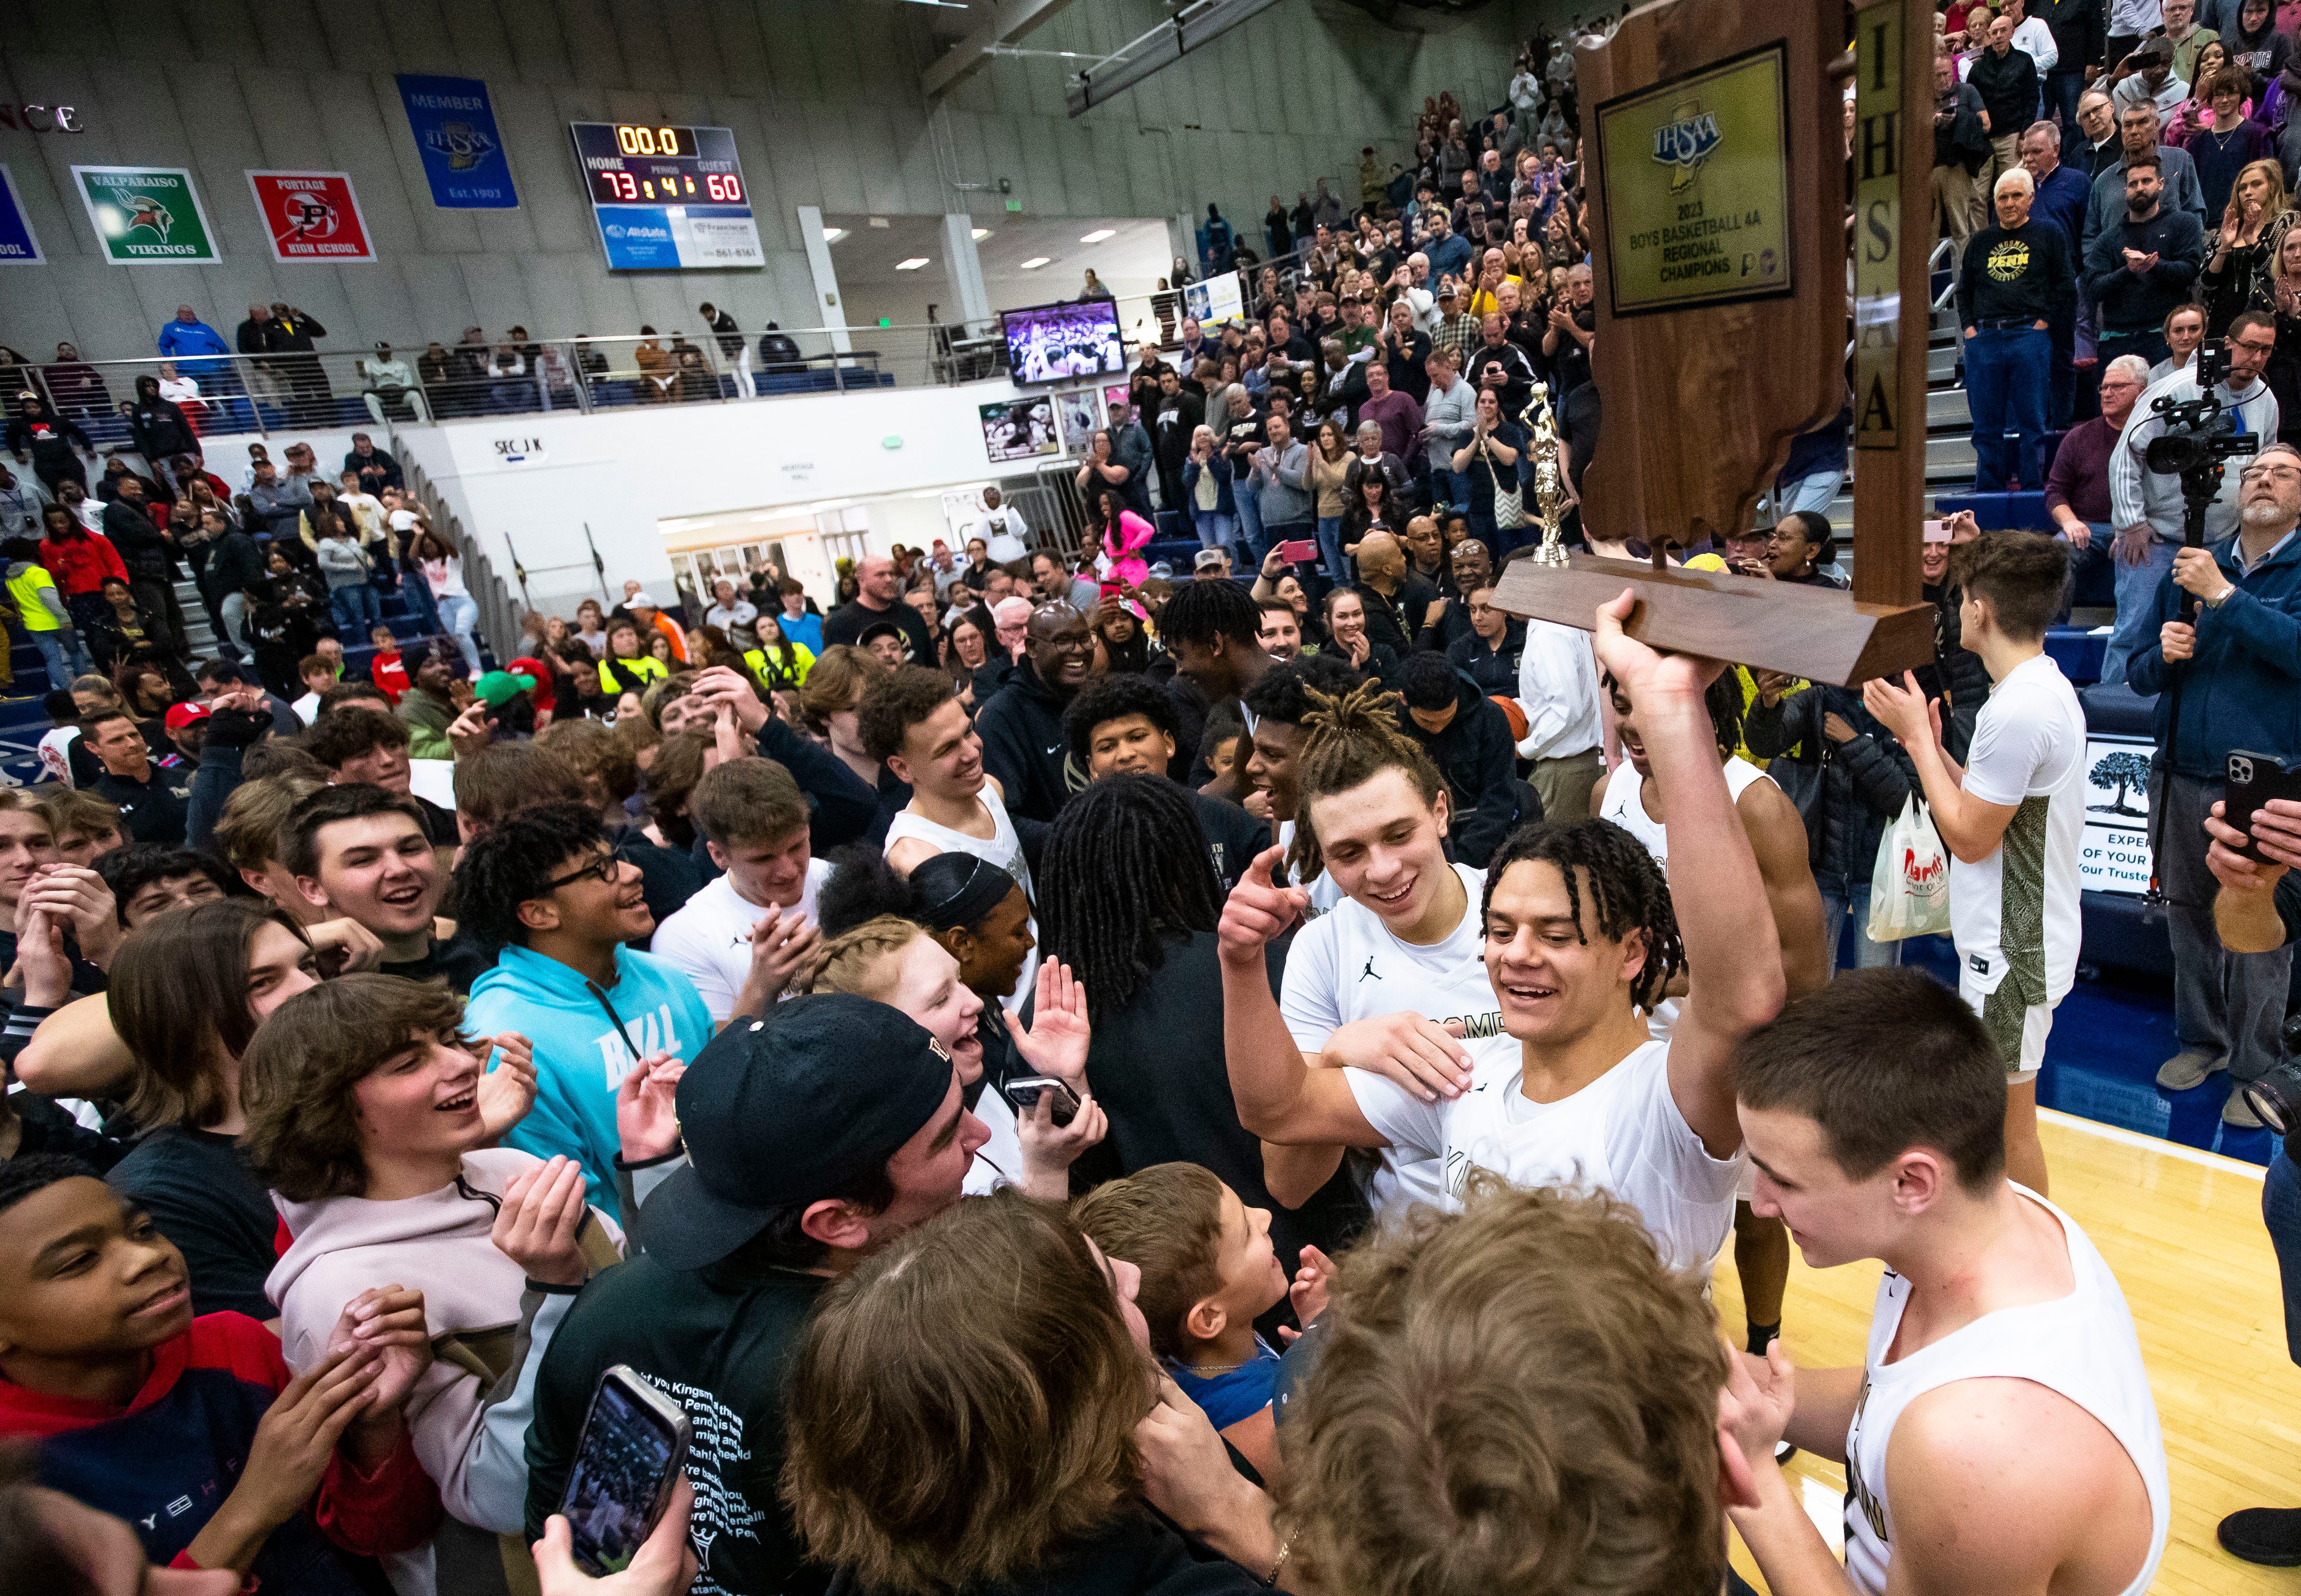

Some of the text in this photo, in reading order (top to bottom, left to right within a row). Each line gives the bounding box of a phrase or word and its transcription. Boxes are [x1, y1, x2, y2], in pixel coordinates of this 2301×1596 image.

[411, 95, 484, 110] MEMBER
[618, 127, 679, 156] 00.0
[1654, 115, 1720, 160] IHSAA
[586, 157, 625, 171] HOME
[651, 165, 680, 175] PERIOD
[697, 159, 733, 172] GUEST
[91, 176, 178, 188] VALPARAISO
[276, 179, 328, 191] PORTAGE
[601, 171, 638, 200] 73
[660, 177, 678, 197] 4
[706, 173, 742, 201] 60
[472, 189, 502, 199] 1903
[1678, 201, 1703, 221] 2023
[1630, 209, 1761, 249] BOYS BASKETBALL 4A
[126, 245, 197, 255] VIKINGS
[287, 243, 360, 254] HIGH SCHOOL
[1663, 238, 1724, 262] REGIONAL
[1987, 253, 2029, 268] PENN
[1660, 257, 1730, 282] CHAMPIONS
[2082, 848, 2147, 865] OF YOUR
[2108, 867, 2148, 882] Truste
[655, 1376, 670, 1391] you
